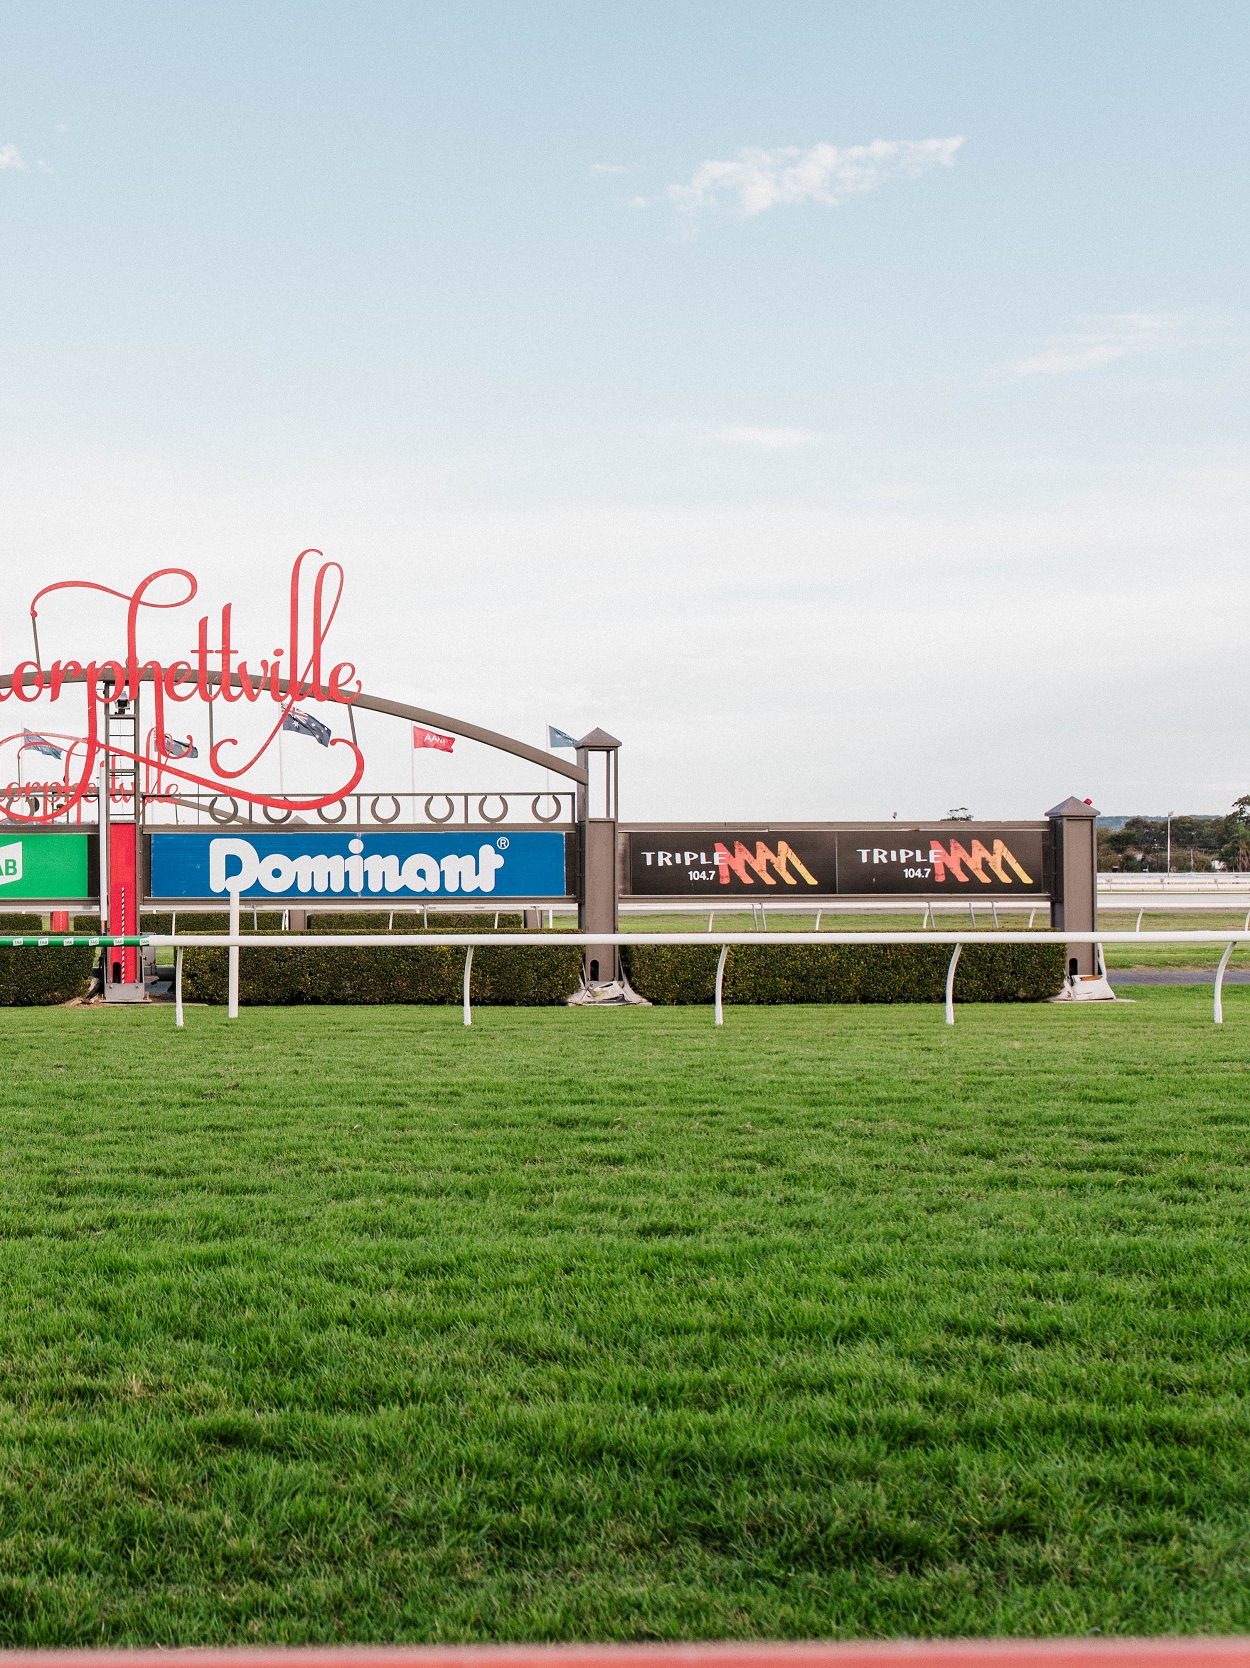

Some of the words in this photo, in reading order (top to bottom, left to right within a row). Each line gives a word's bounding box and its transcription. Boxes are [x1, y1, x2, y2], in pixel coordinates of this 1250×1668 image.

[641, 850, 728, 866] TRIPLE
[856, 848, 943, 864] TRIPLE
[687, 870, 716, 881] 104.7
[903, 868, 931, 879] 104.7
